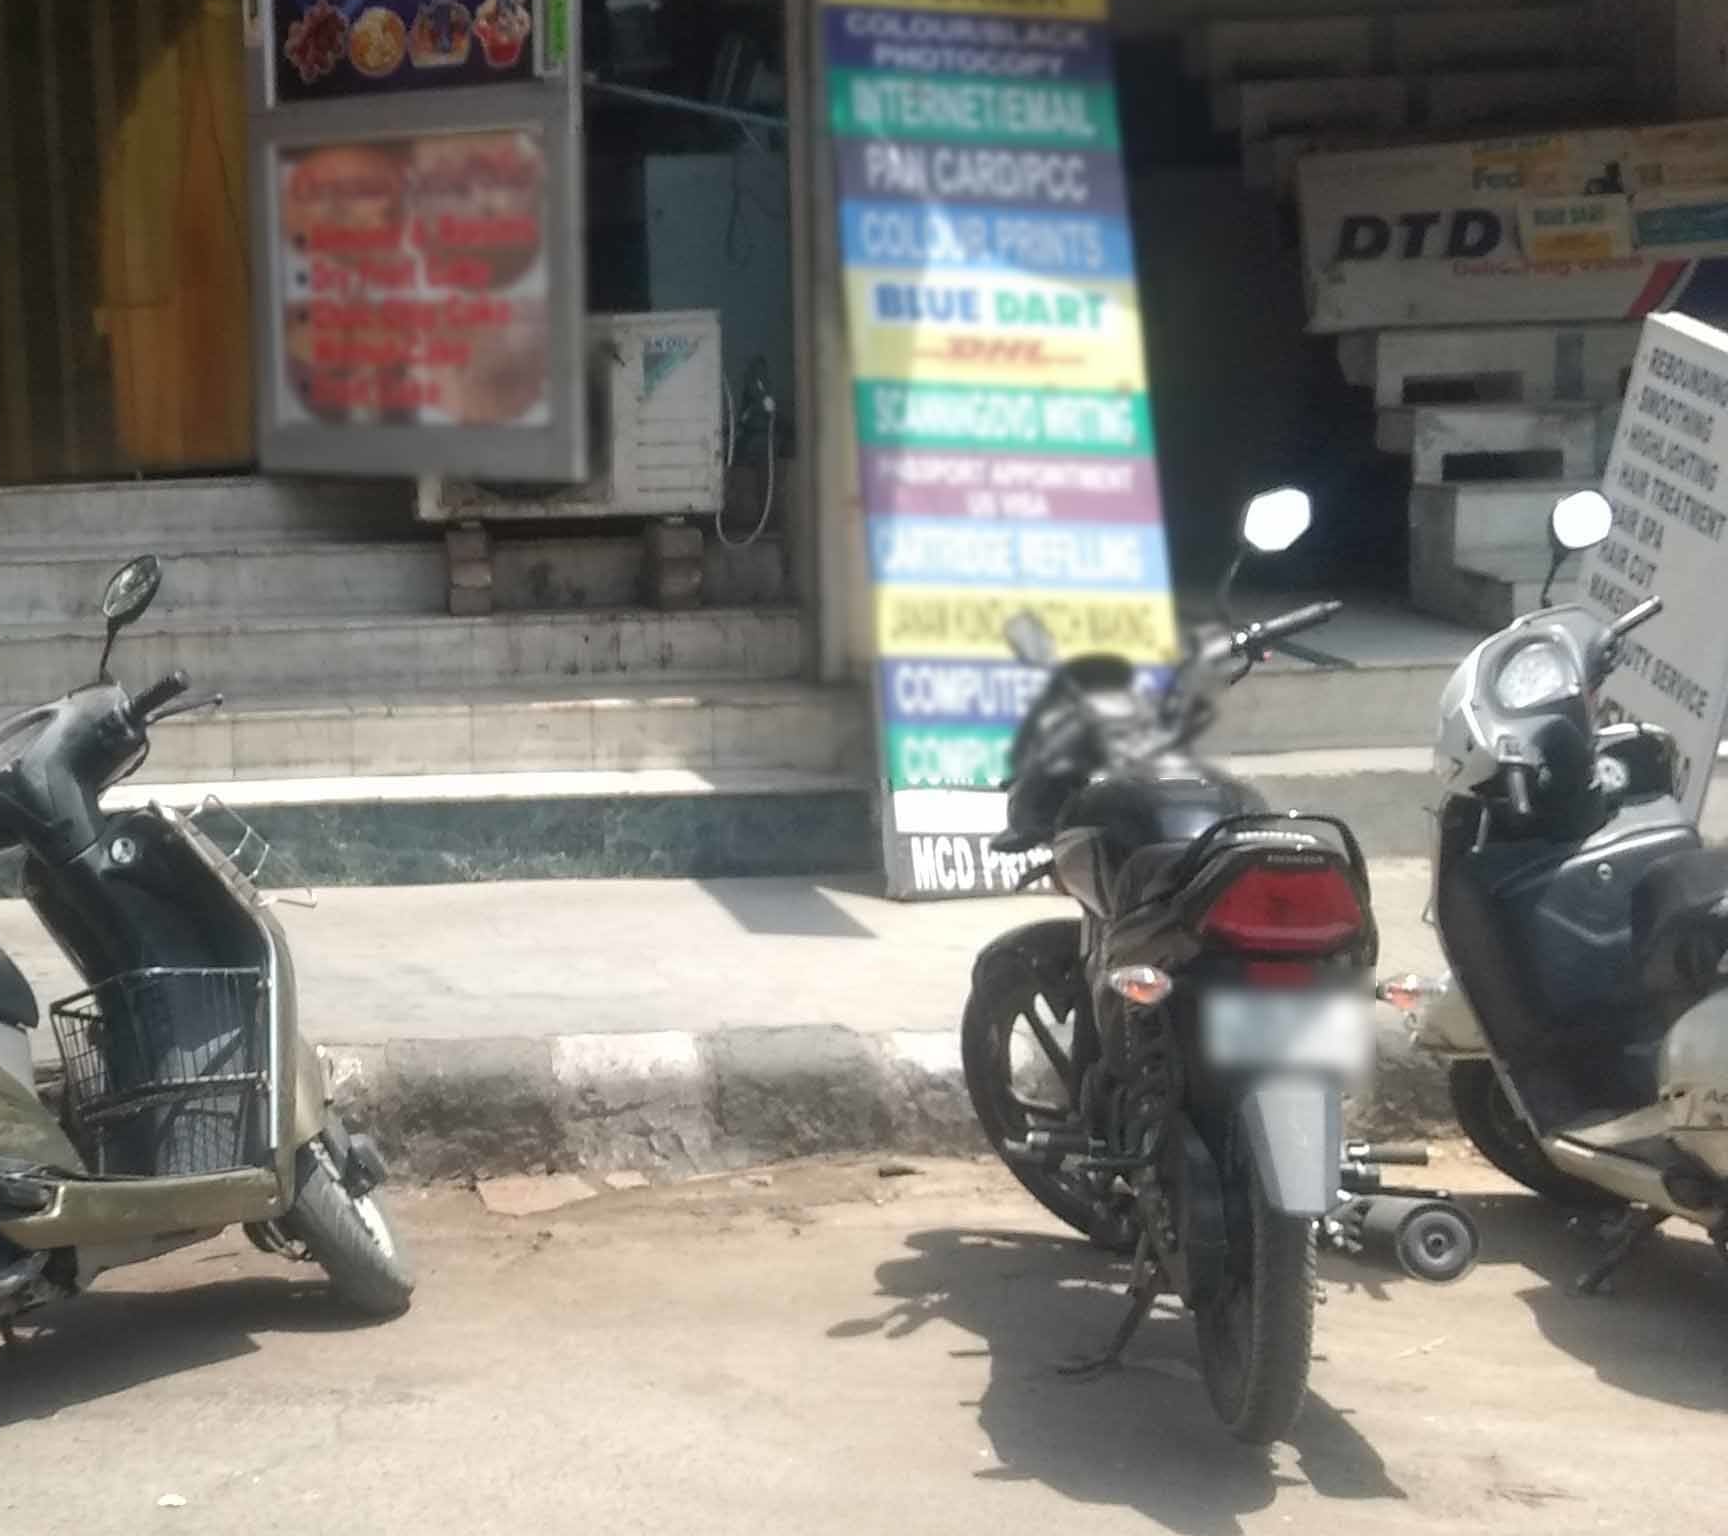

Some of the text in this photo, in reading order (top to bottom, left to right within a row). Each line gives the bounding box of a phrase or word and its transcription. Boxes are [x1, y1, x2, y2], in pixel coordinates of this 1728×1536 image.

[874, 280, 1106, 331] BLUE DART
[910, 835, 976, 891] MCD
